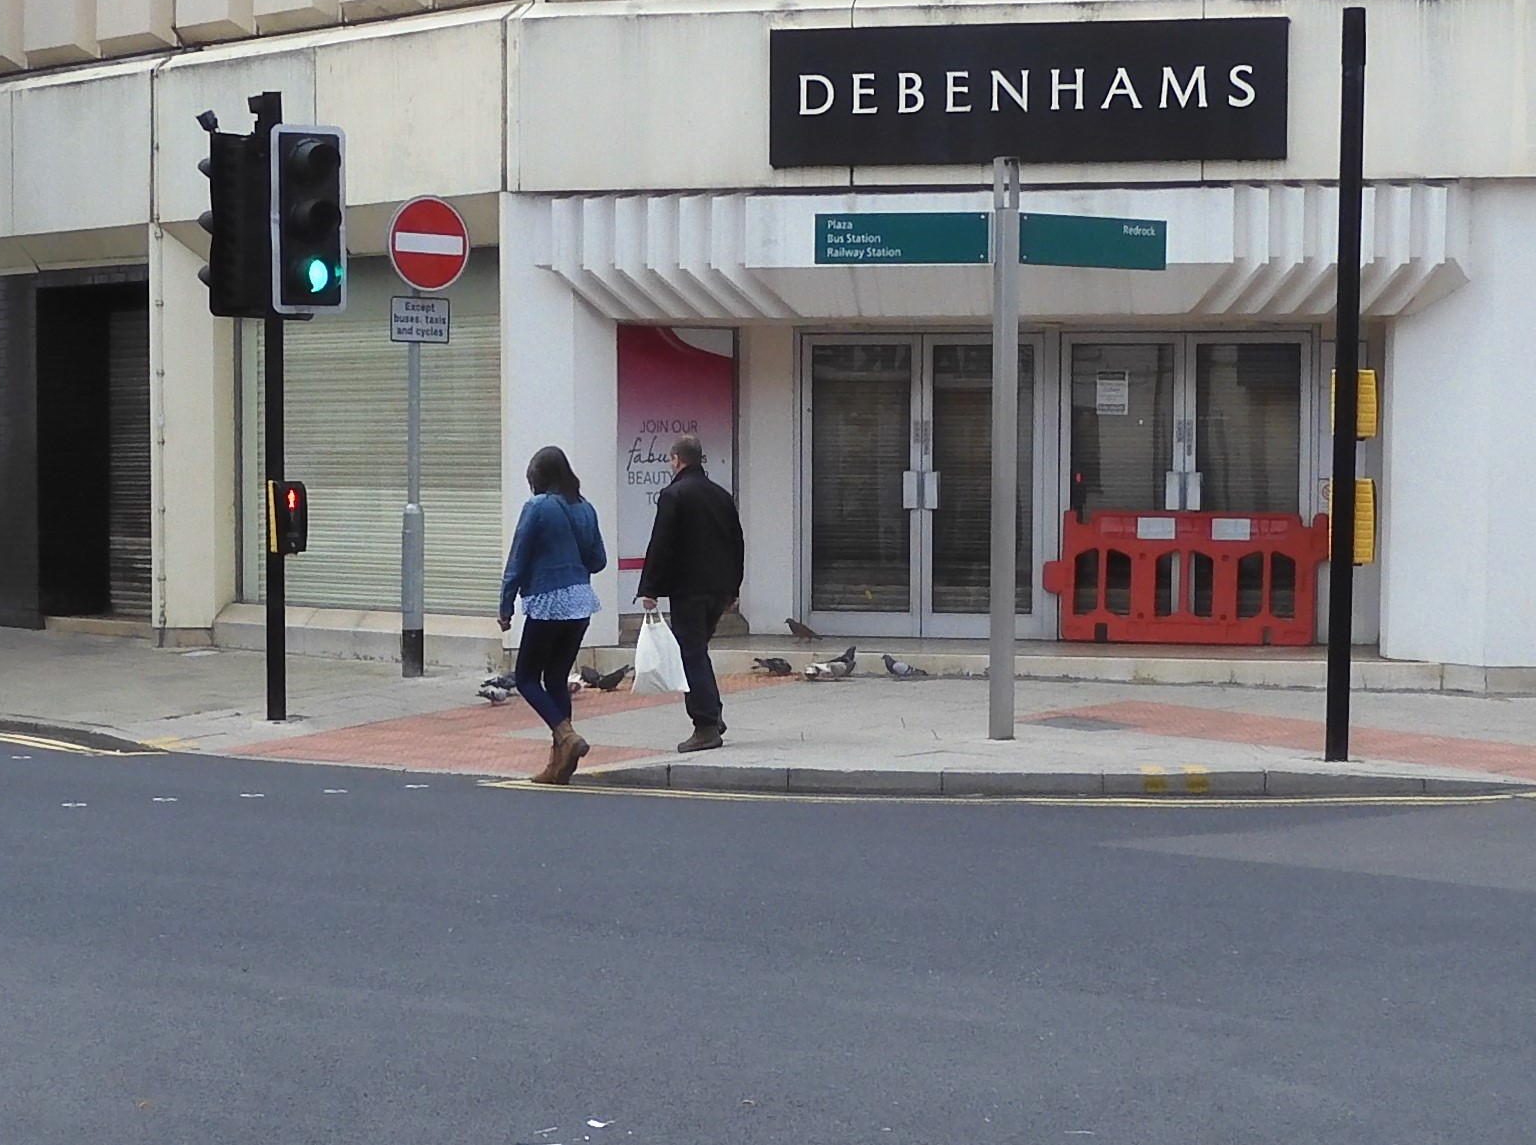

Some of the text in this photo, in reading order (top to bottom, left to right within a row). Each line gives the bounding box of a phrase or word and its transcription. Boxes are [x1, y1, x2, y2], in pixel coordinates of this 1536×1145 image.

[798, 64, 1257, 116] DEBENHAMS
[827, 219, 853, 230] Plaza
[1123, 224, 1156, 236] Redrock
[827, 232, 881, 244] Bus Station
[827, 246, 902, 259] Railway Station
[405, 301, 436, 313] Except
[425, 315, 447, 325] taxis
[397, 326, 444, 337] and cycles
[640, 419, 698, 433] JOIN OUR
[627, 471, 676, 485] BEAUTY
